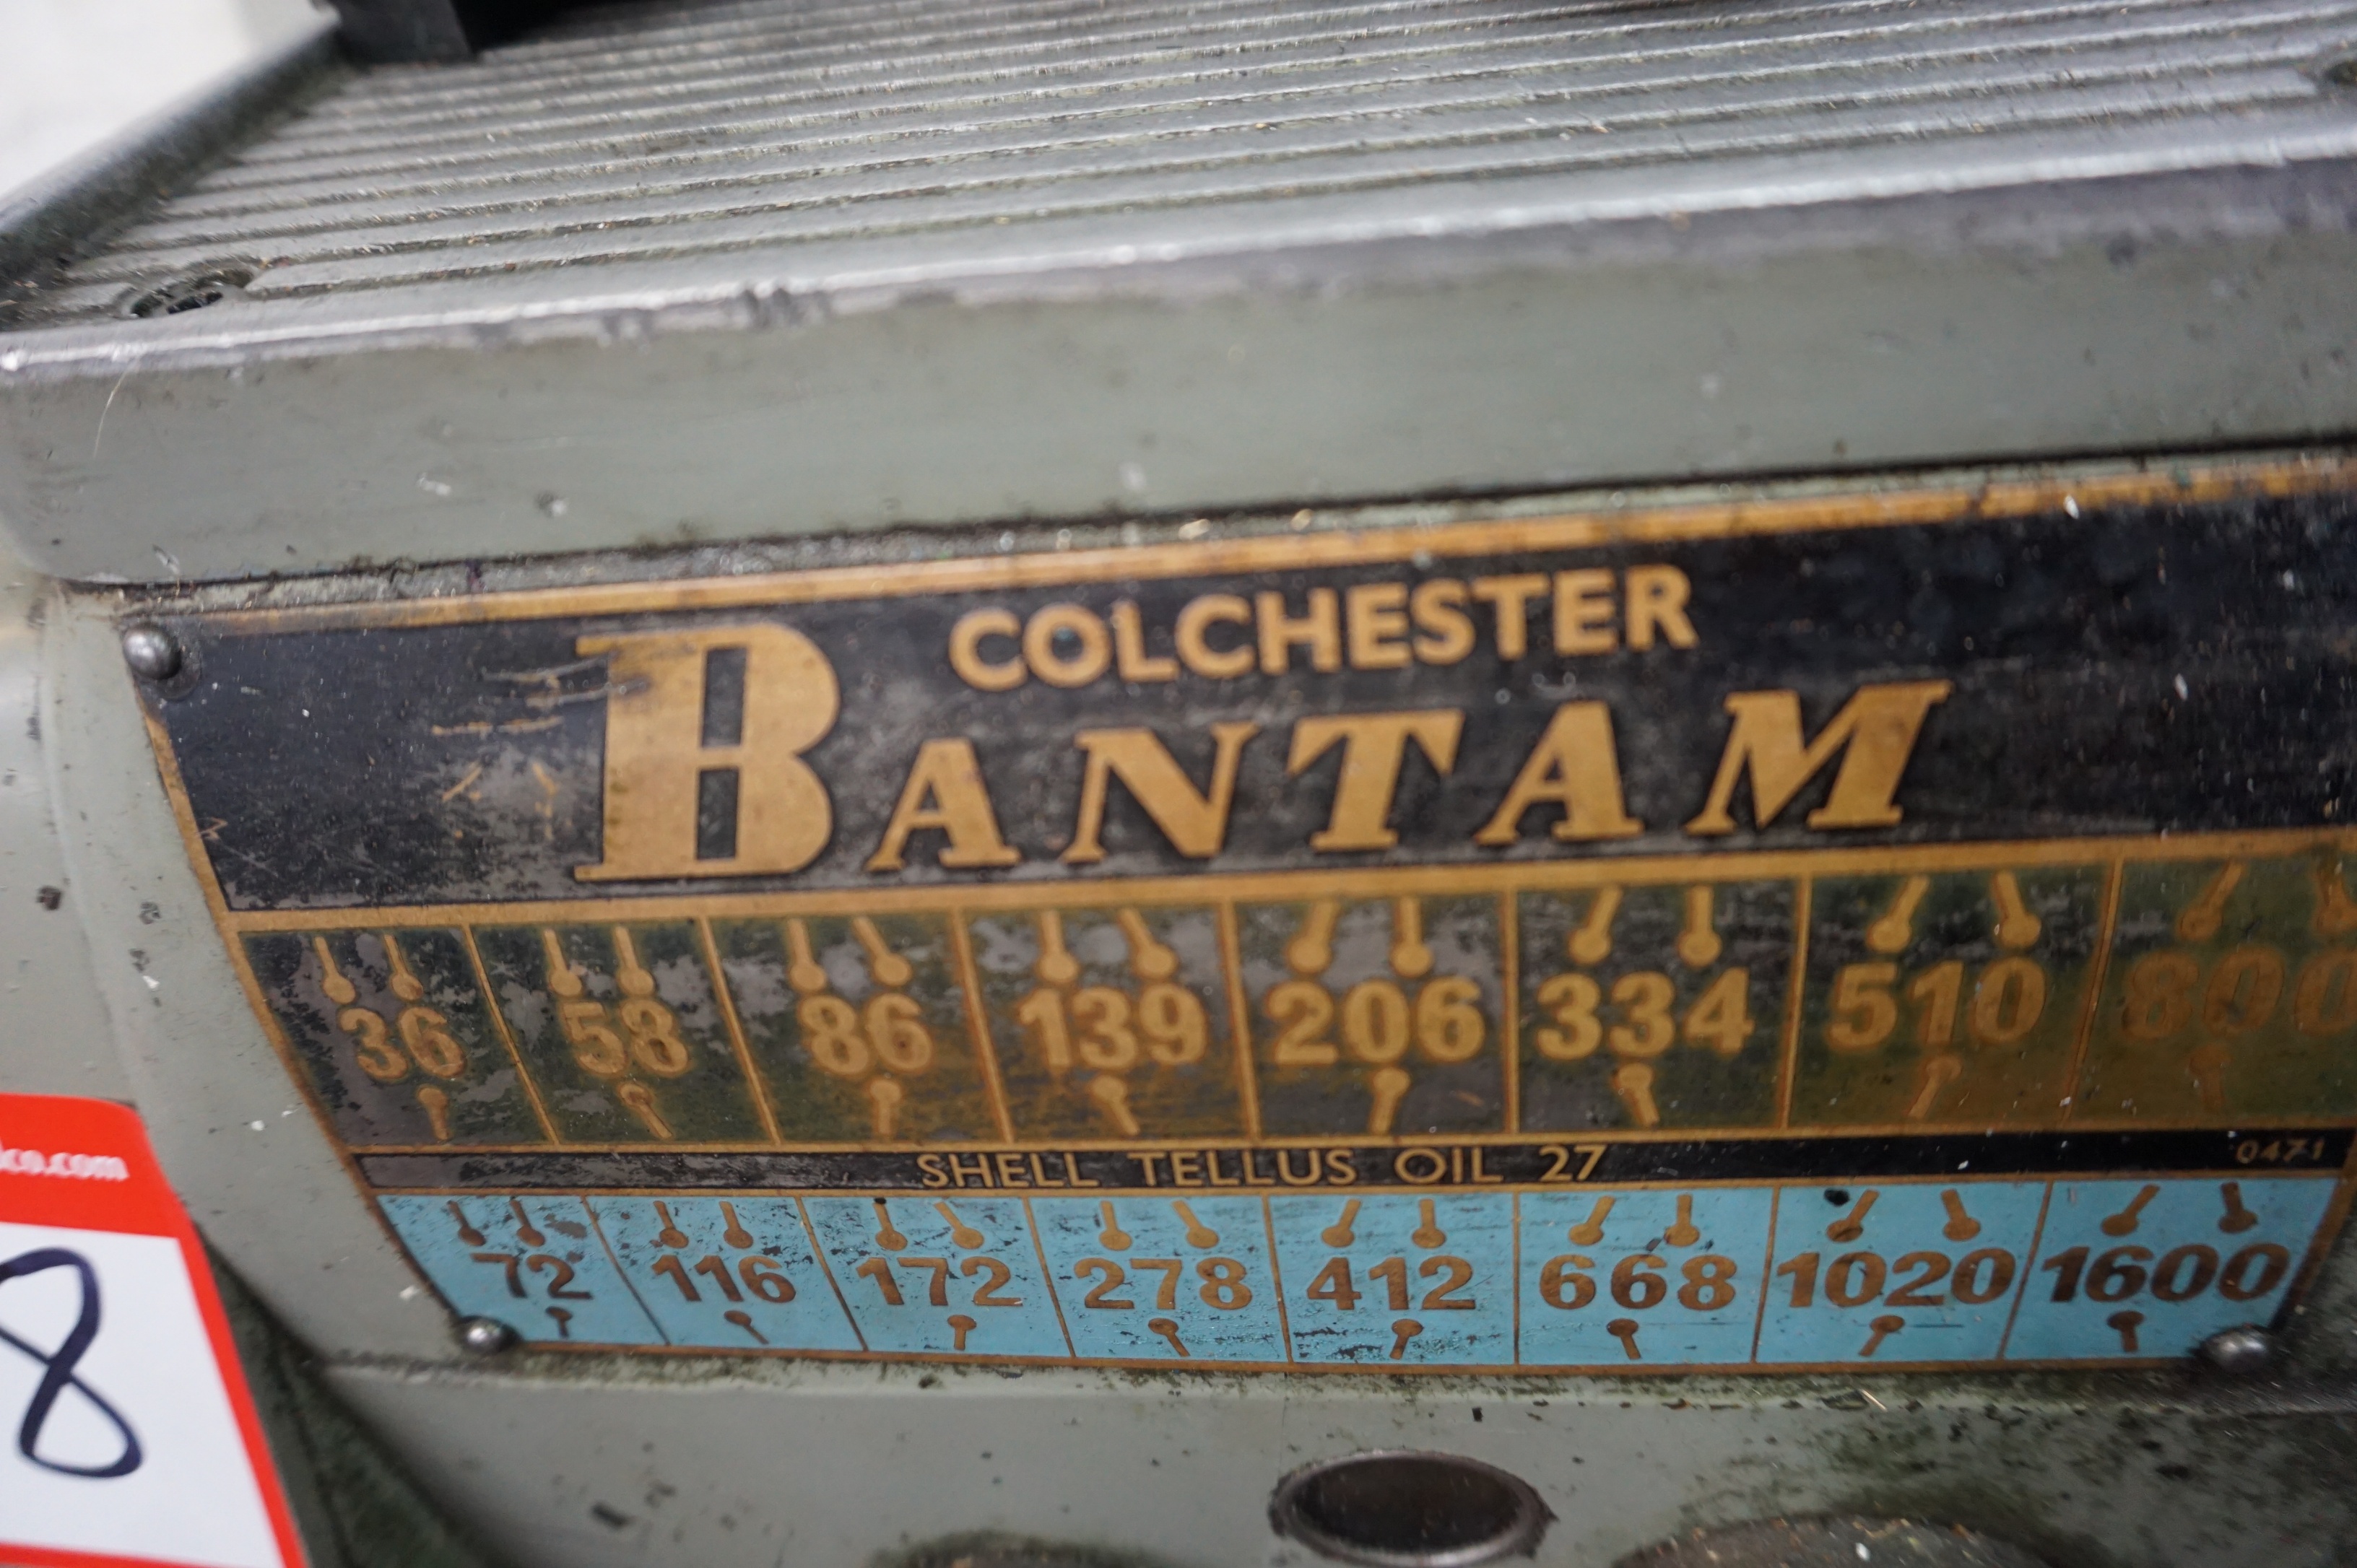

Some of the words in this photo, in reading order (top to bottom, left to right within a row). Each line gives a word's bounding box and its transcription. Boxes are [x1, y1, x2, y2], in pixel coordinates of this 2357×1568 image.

[949, 564, 1700, 691] COLCHESTER
[339, 1006, 466, 1079] 36
[559, 999, 689, 1077] 58
[796, 993, 934, 1075] 86
[1019, 982, 1210, 1069] 139
[1265, 975, 1486, 1065] 206
[1537, 967, 1755, 1060] 334
[1824, 957, 2046, 1052] 510
[2121, 946, 2357, 1040] 800
[0, 1146, 129, 1182] co.com
[916, 1152, 1101, 1188] SHELL
[1127, 1148, 1358, 1188] TELLUS
[1394, 1147, 1504, 1185] OIL
[1538, 1144, 1607, 1182] 27
[2236, 1138, 2325, 1164] 0471
[471, 1253, 593, 1300] 72
[651, 1254, 796, 1304] 116
[856, 1256, 1024, 1307] 172
[1074, 1257, 1253, 1310] 278
[1306, 1255, 1477, 1311] 412
[1538, 1254, 1738, 1311] 668
[1776, 1247, 2017, 1308] 1020
[2041, 1243, 2291, 1303] 1600
[0, 1247, 146, 1478] 8
